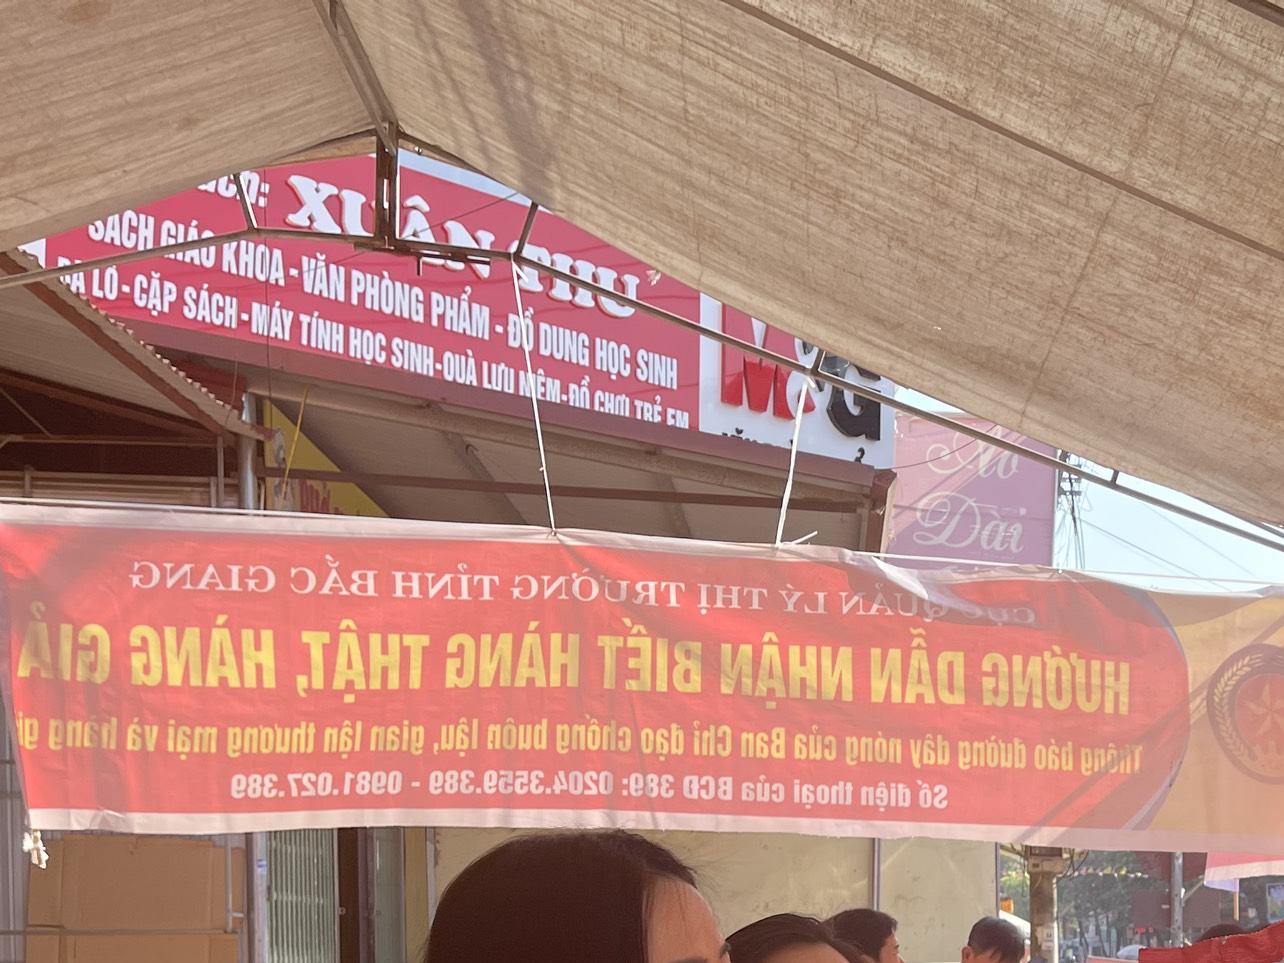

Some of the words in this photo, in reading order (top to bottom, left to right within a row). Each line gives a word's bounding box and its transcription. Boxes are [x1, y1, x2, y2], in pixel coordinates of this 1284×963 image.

[133, 270, 177, 317] CẶP
[183, 283, 238, 329] SÁCH
[251, 301, 294, 341] MÁY
[299, 311, 345, 358] TÍNH
[222, 239, 286, 287] KHOA
[302, 252, 346, 303] VĂN
[350, 270, 424, 323] PHÒNG
[431, 285, 490, 341] PHẨM
[595, 337, 631, 381] HỌC
[636, 348, 678, 390] SINH
